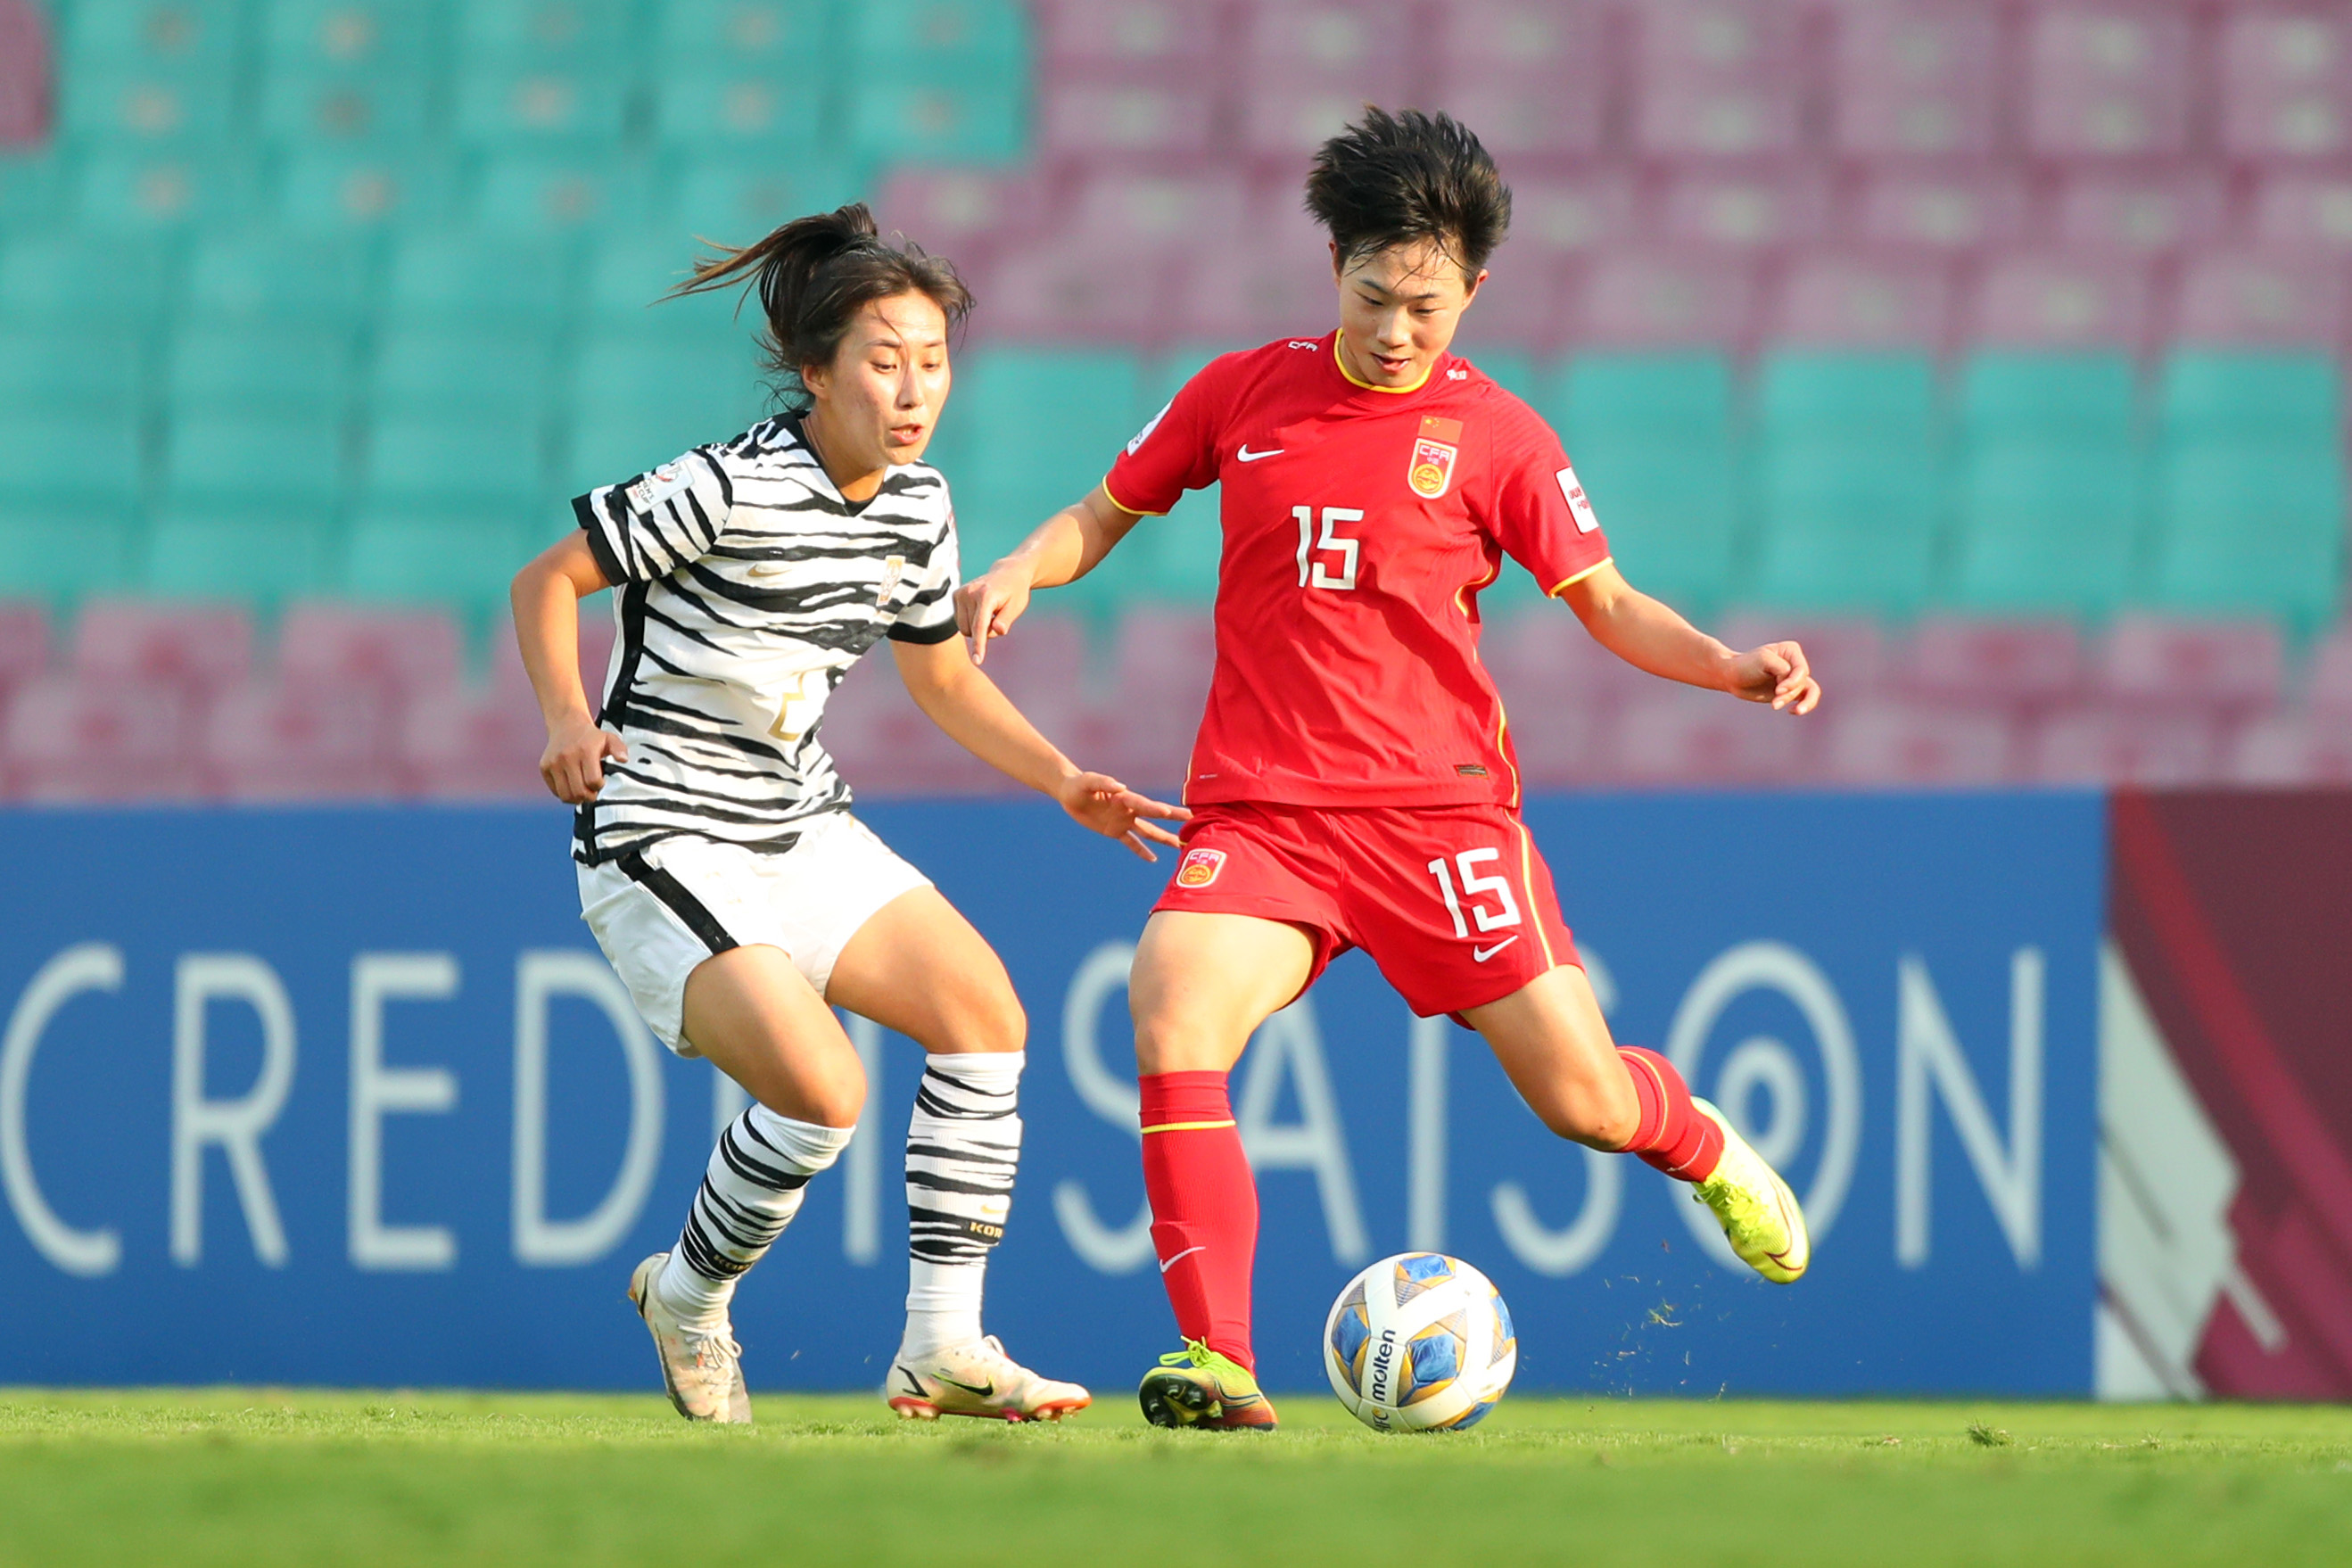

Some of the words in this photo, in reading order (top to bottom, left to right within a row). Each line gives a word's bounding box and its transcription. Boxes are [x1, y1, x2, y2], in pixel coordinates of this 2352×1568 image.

[1419, 444, 1450, 461] CFA
[1292, 506, 1365, 590] 15
[1190, 852, 1220, 862] CFA
[1428, 847, 1521, 938] 15
[0, 939, 881, 1277] CREDT
[1373, 1328, 1396, 1402] molten
